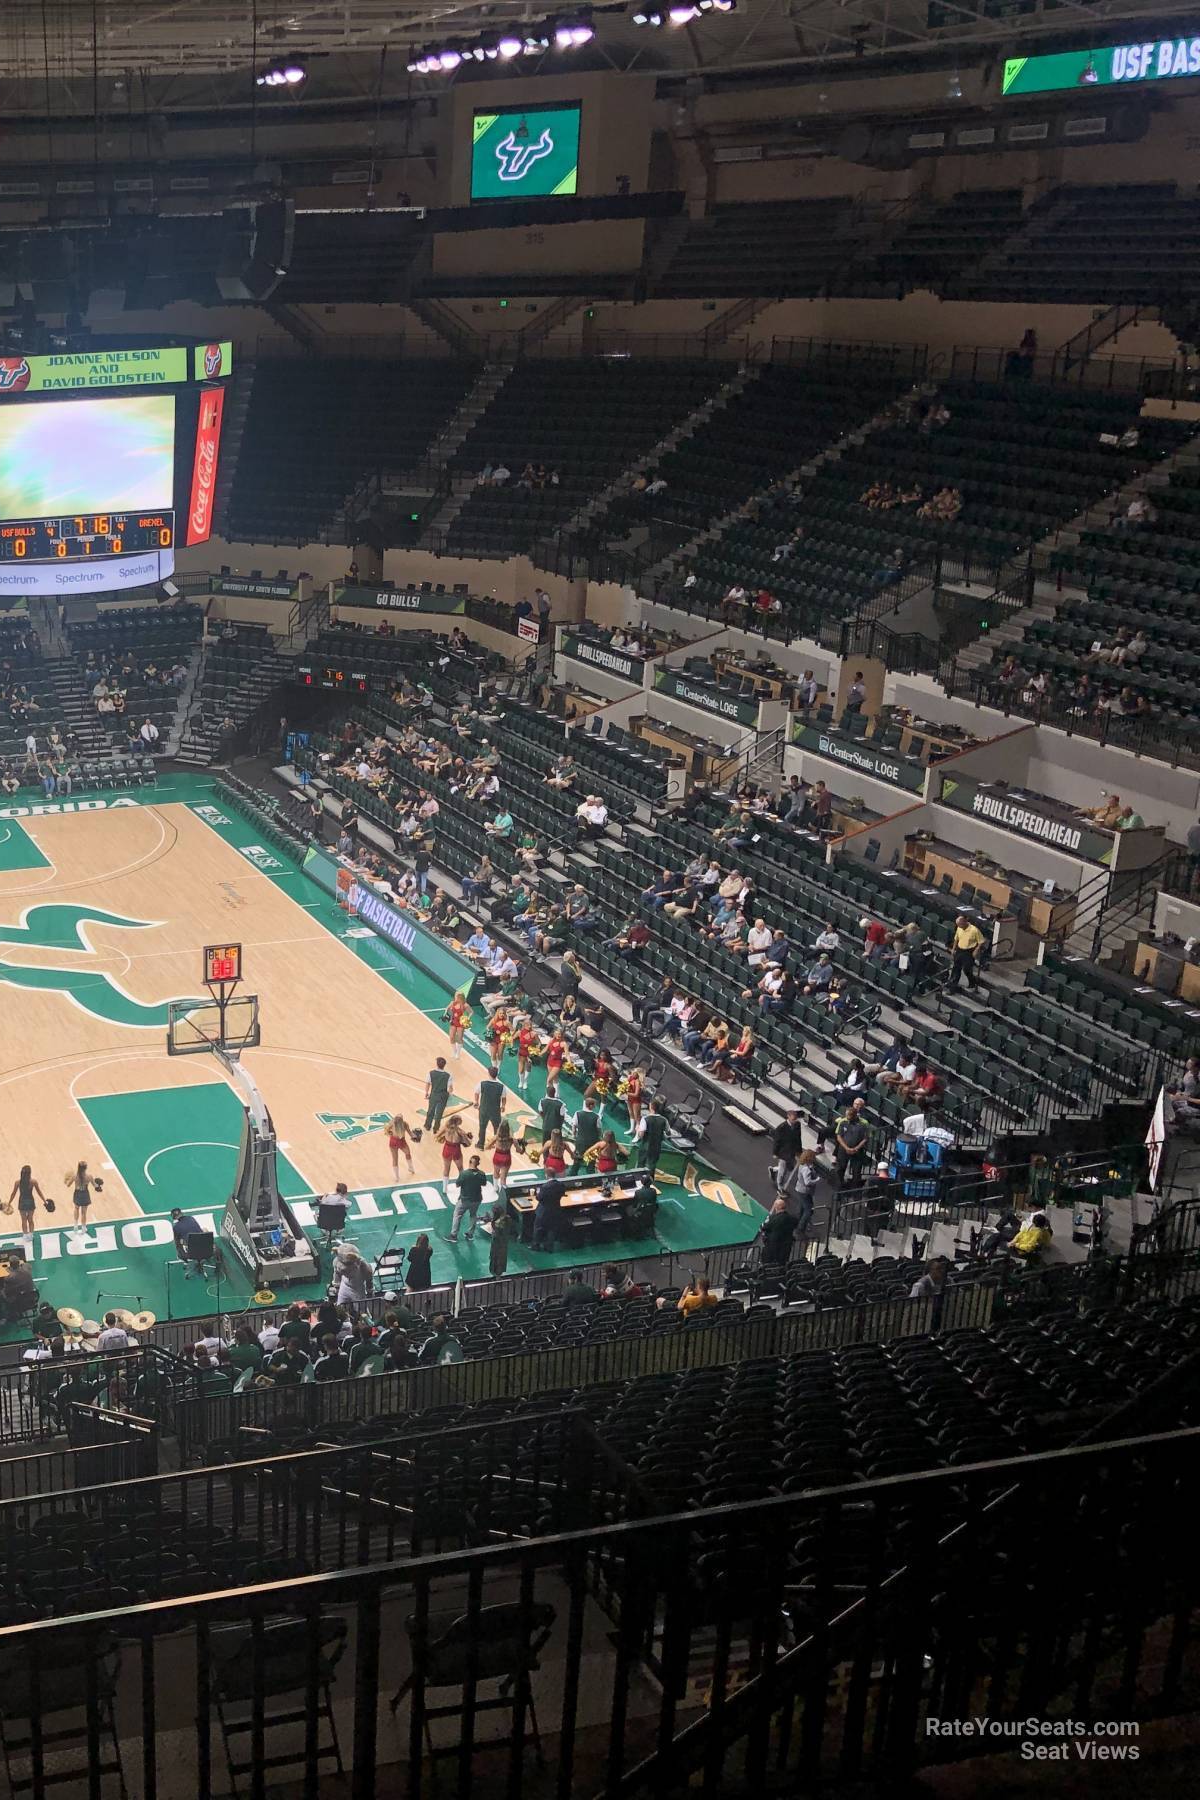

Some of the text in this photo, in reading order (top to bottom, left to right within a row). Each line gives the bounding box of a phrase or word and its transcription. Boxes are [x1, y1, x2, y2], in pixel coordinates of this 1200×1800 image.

[1112, 42, 1155, 80] USF
[47, 351, 160, 366] JOANNE NELSON
[89, 364, 119, 375] AND
[42, 372, 166, 389] DAVID GOLDSTEIN
[74, 516, 110, 535] 7:16
[117, 522, 125, 532] 4
[138, 518, 165, 528] DREXEL
[46, 528, 55, 537] 4
[159, 528, 171, 547] 0
[14, 538, 27, 557] 0
[57, 543, 67, 557] 0
[112, 539, 122, 553] 0
[55, 571, 103, 584] Spectrum
[119, 563, 154, 578] Spectrum
[222, 583, 248, 591] UNIVERSITY
[377, 593, 420, 608] GO BULLS!
[577, 643, 632, 675] #BULLSPEEDAHEAD
[684, 687, 739, 717] CenterState LOGE
[828, 742, 899, 780] CenterState LOGE
[973, 793, 1082, 850] #BULLSPEEDAHEAD
[362, 894, 417, 951] BASKETBALL
